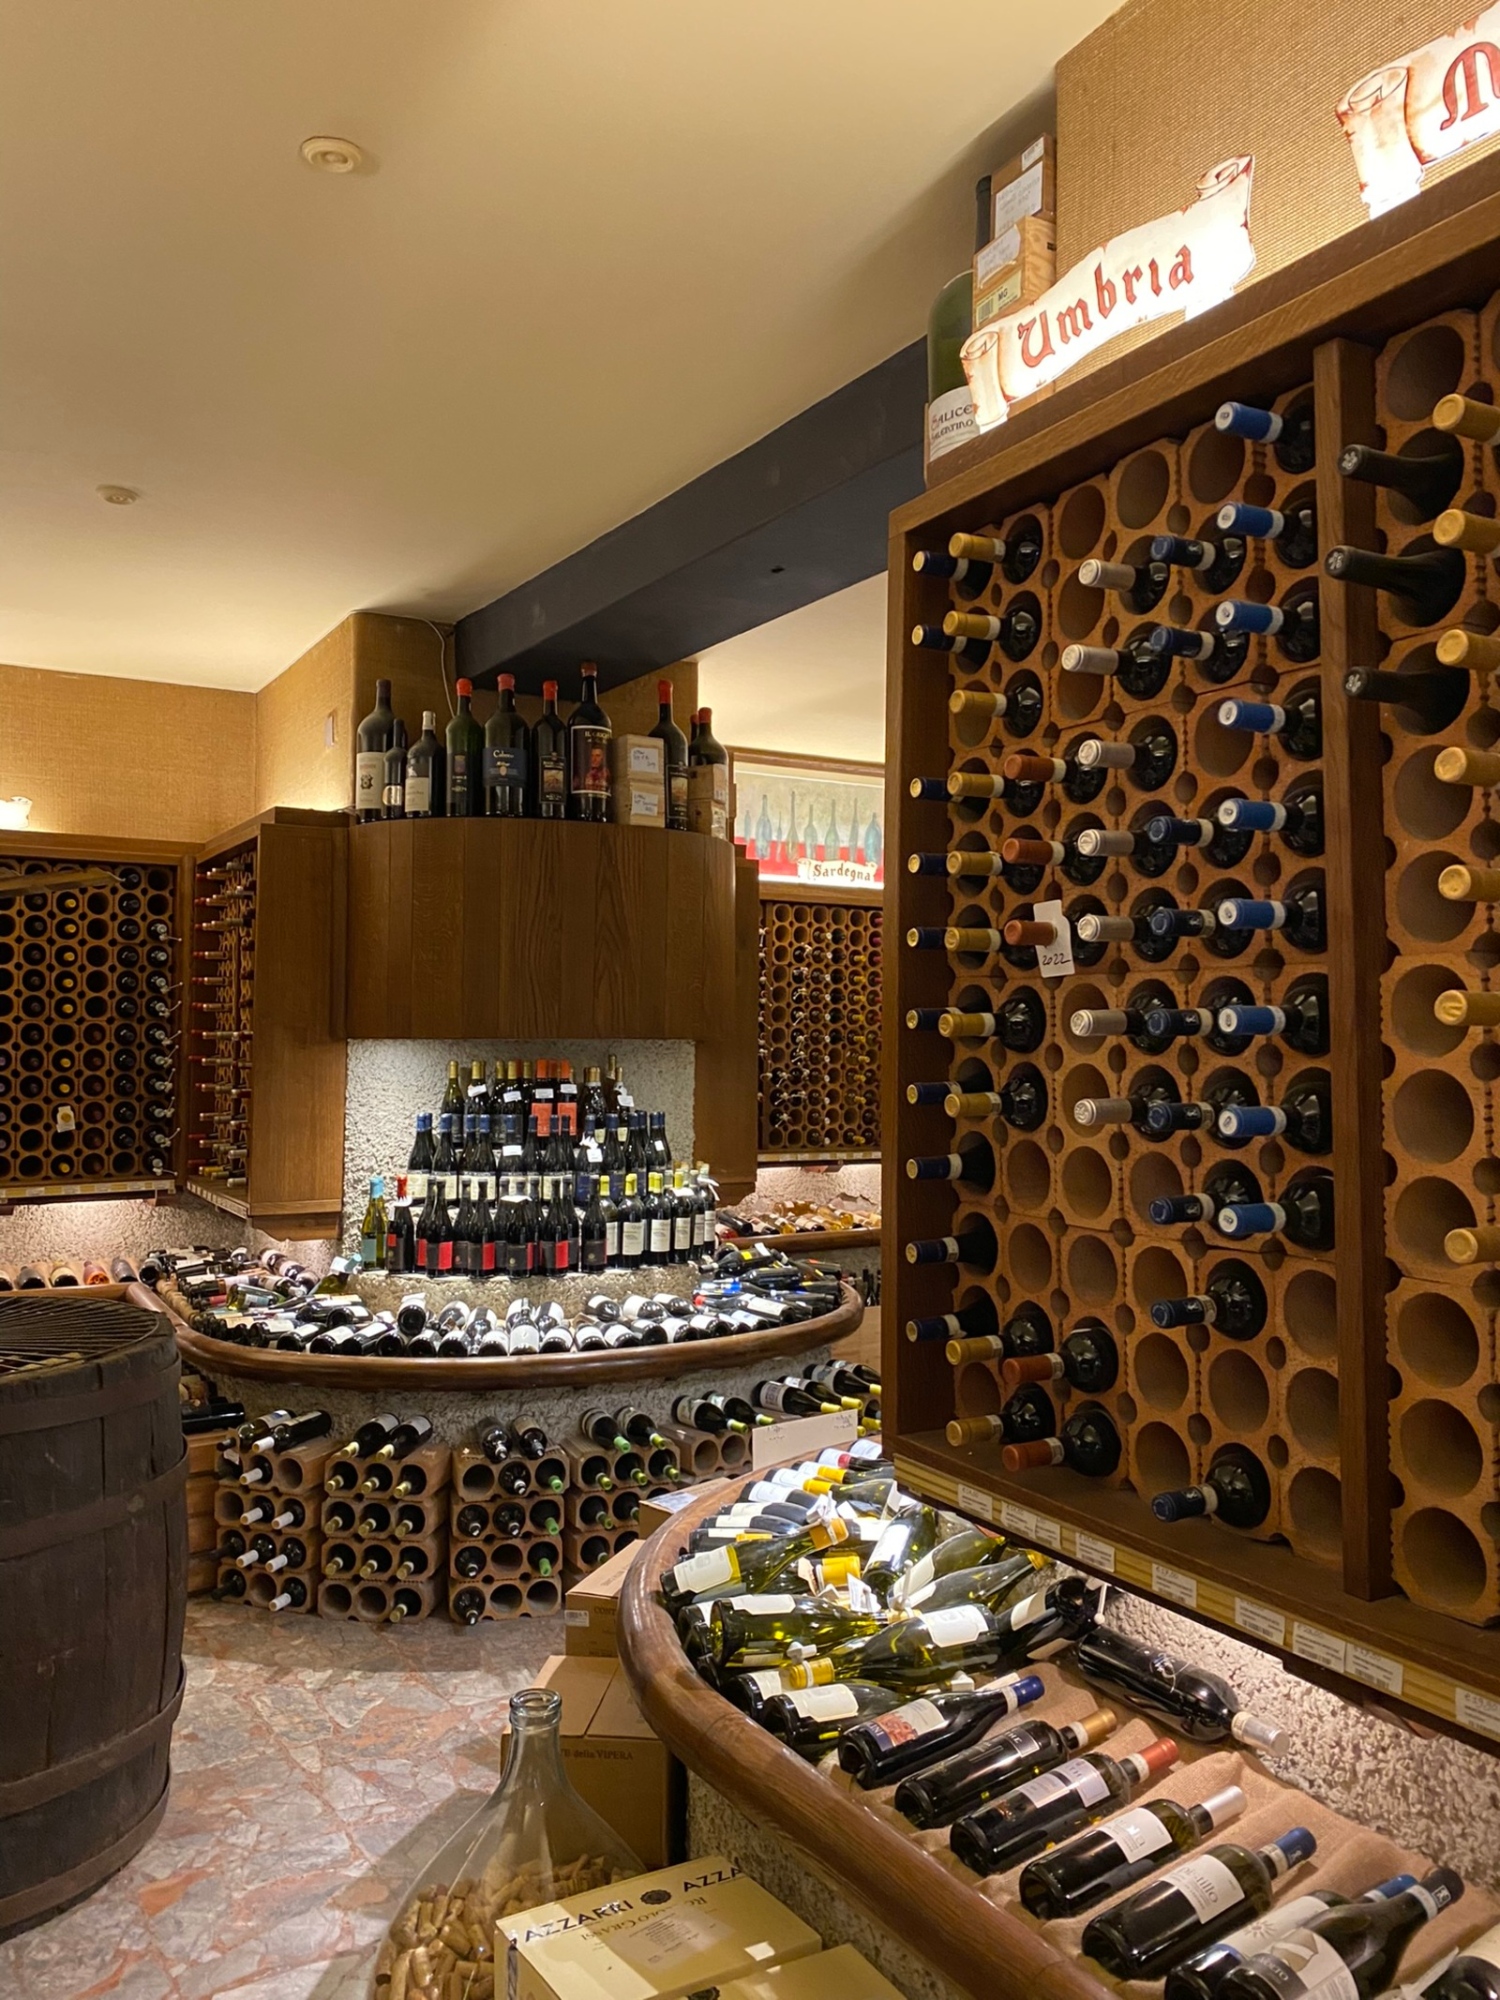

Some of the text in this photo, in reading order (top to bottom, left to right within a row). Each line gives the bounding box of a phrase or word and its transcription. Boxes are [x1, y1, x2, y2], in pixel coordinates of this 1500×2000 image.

[1016, 243, 1195, 370] Umbria
[813, 862, 871, 882] Sardegna
[1042, 952, 1071, 966] 2022
[596, 1749, 634, 1761] VIPERA
